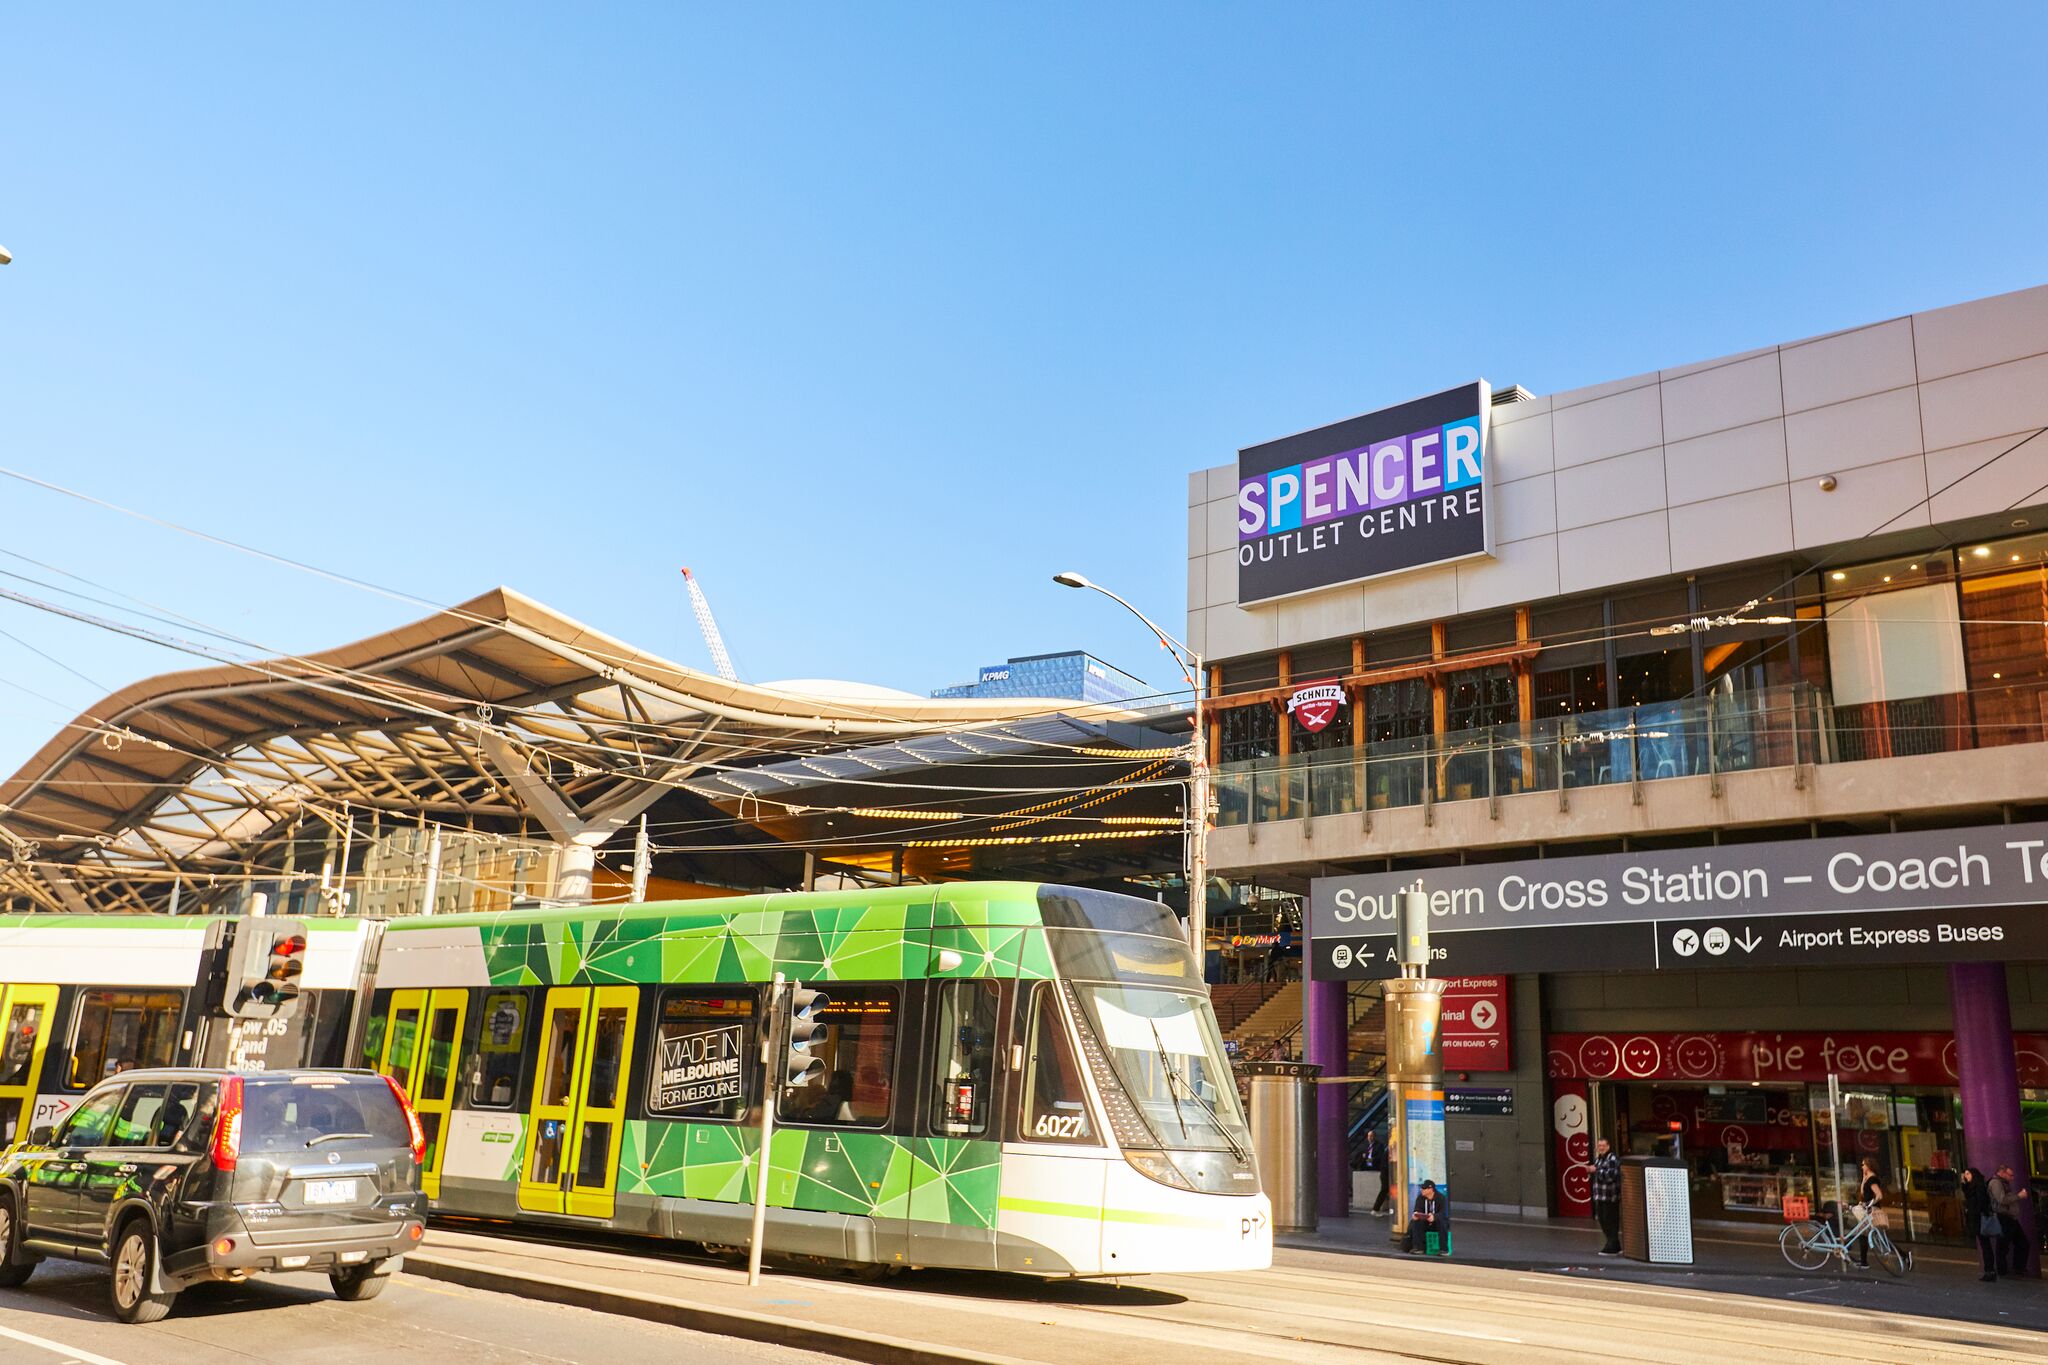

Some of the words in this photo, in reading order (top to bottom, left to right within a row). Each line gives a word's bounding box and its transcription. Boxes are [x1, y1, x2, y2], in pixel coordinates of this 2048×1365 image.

[1239, 425, 1481, 534] SPENCER
[1239, 521, 1344, 566] OUTLET
[1360, 488, 1480, 538] CENTRE
[982, 670, 1009, 682] KPMG
[1296, 688, 1336, 702] SCHNITZ
[1334, 887, 1484, 922] Souern
[1498, 875, 1608, 912] Cross
[1621, 863, 1769, 906] Station
[1827, 845, 1991, 894] Coach
[2005, 840, 2048, 884] T
[1779, 929, 1843, 950] Airport
[1850, 927, 1930, 948] Express
[1937, 924, 2004, 942] Buses
[1462, 978, 1498, 989] Express
[664, 1034, 718, 1068] MADE
[722, 1030, 740, 1058] IN
[1752, 1034, 1805, 1079] pie
[1820, 1037, 1910, 1073] face
[663, 1058, 739, 1085] MELBOURNE
[662, 1090, 681, 1105] FOR
[681, 1080, 738, 1101] MELBOURNE
[1035, 1114, 1084, 1138] 6027
